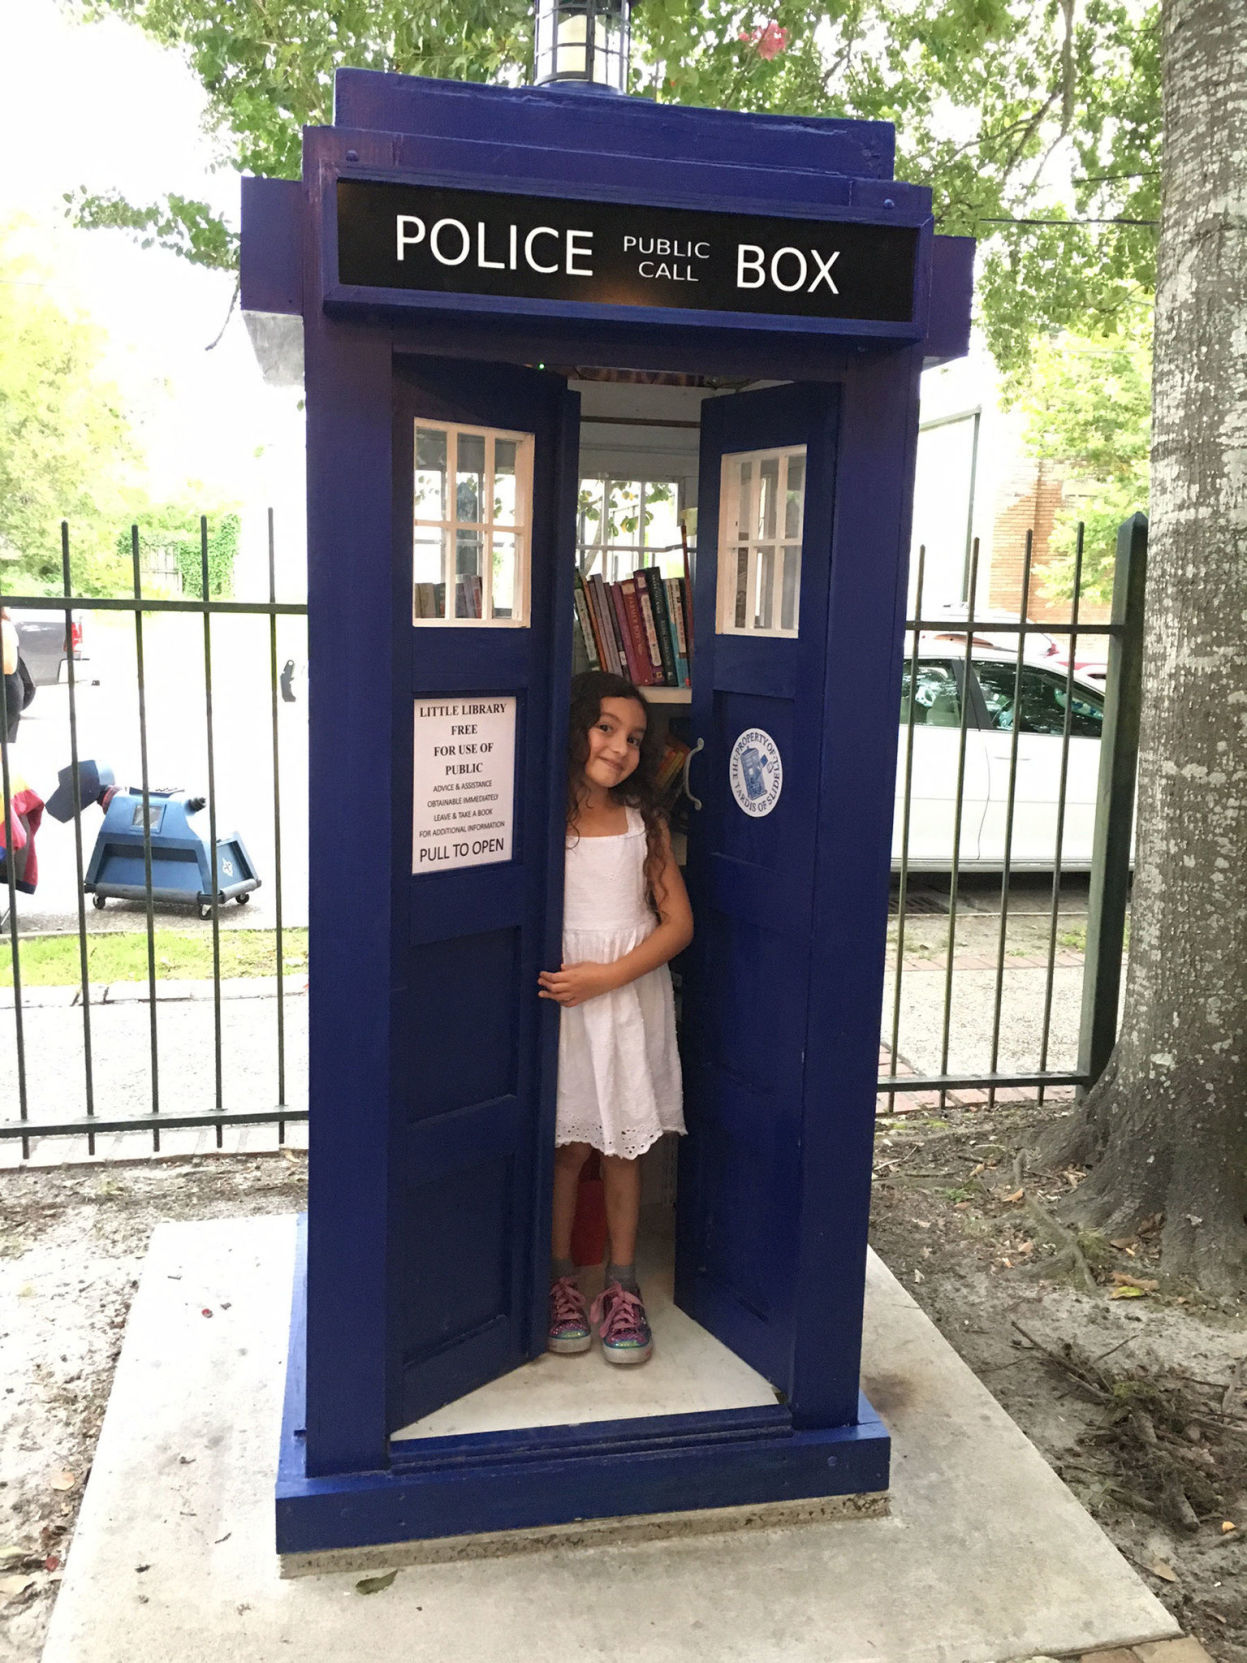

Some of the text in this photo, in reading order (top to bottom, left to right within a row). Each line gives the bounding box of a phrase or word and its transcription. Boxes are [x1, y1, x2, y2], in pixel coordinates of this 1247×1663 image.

[396, 215, 594, 276] POLICE
[623, 235, 711, 259] PUBLIC
[638, 261, 699, 282] CALL
[736, 244, 840, 295] BOX
[420, 704, 507, 717] LITTLE LIBRARY
[451, 724, 478, 736] FREE
[434, 743, 494, 757] FOR USE OF
[735, 732, 776, 756] PROPERTY OF
[445, 763, 483, 776] PUBLIC
[433, 780, 492, 792] ADVICE & ASSISTANCE
[427, 794, 499, 808] OBTAINABLE IMMEDIATELY
[434, 813, 451, 822] LEAVE
[452, 812, 457, 820] &
[458, 810, 471, 819] TAKE
[477, 808, 493, 817] BOOK
[419, 821, 505, 838] FOR ADDITIONAL INFORMATION
[420, 838, 504, 862] PULL TO OPEN
